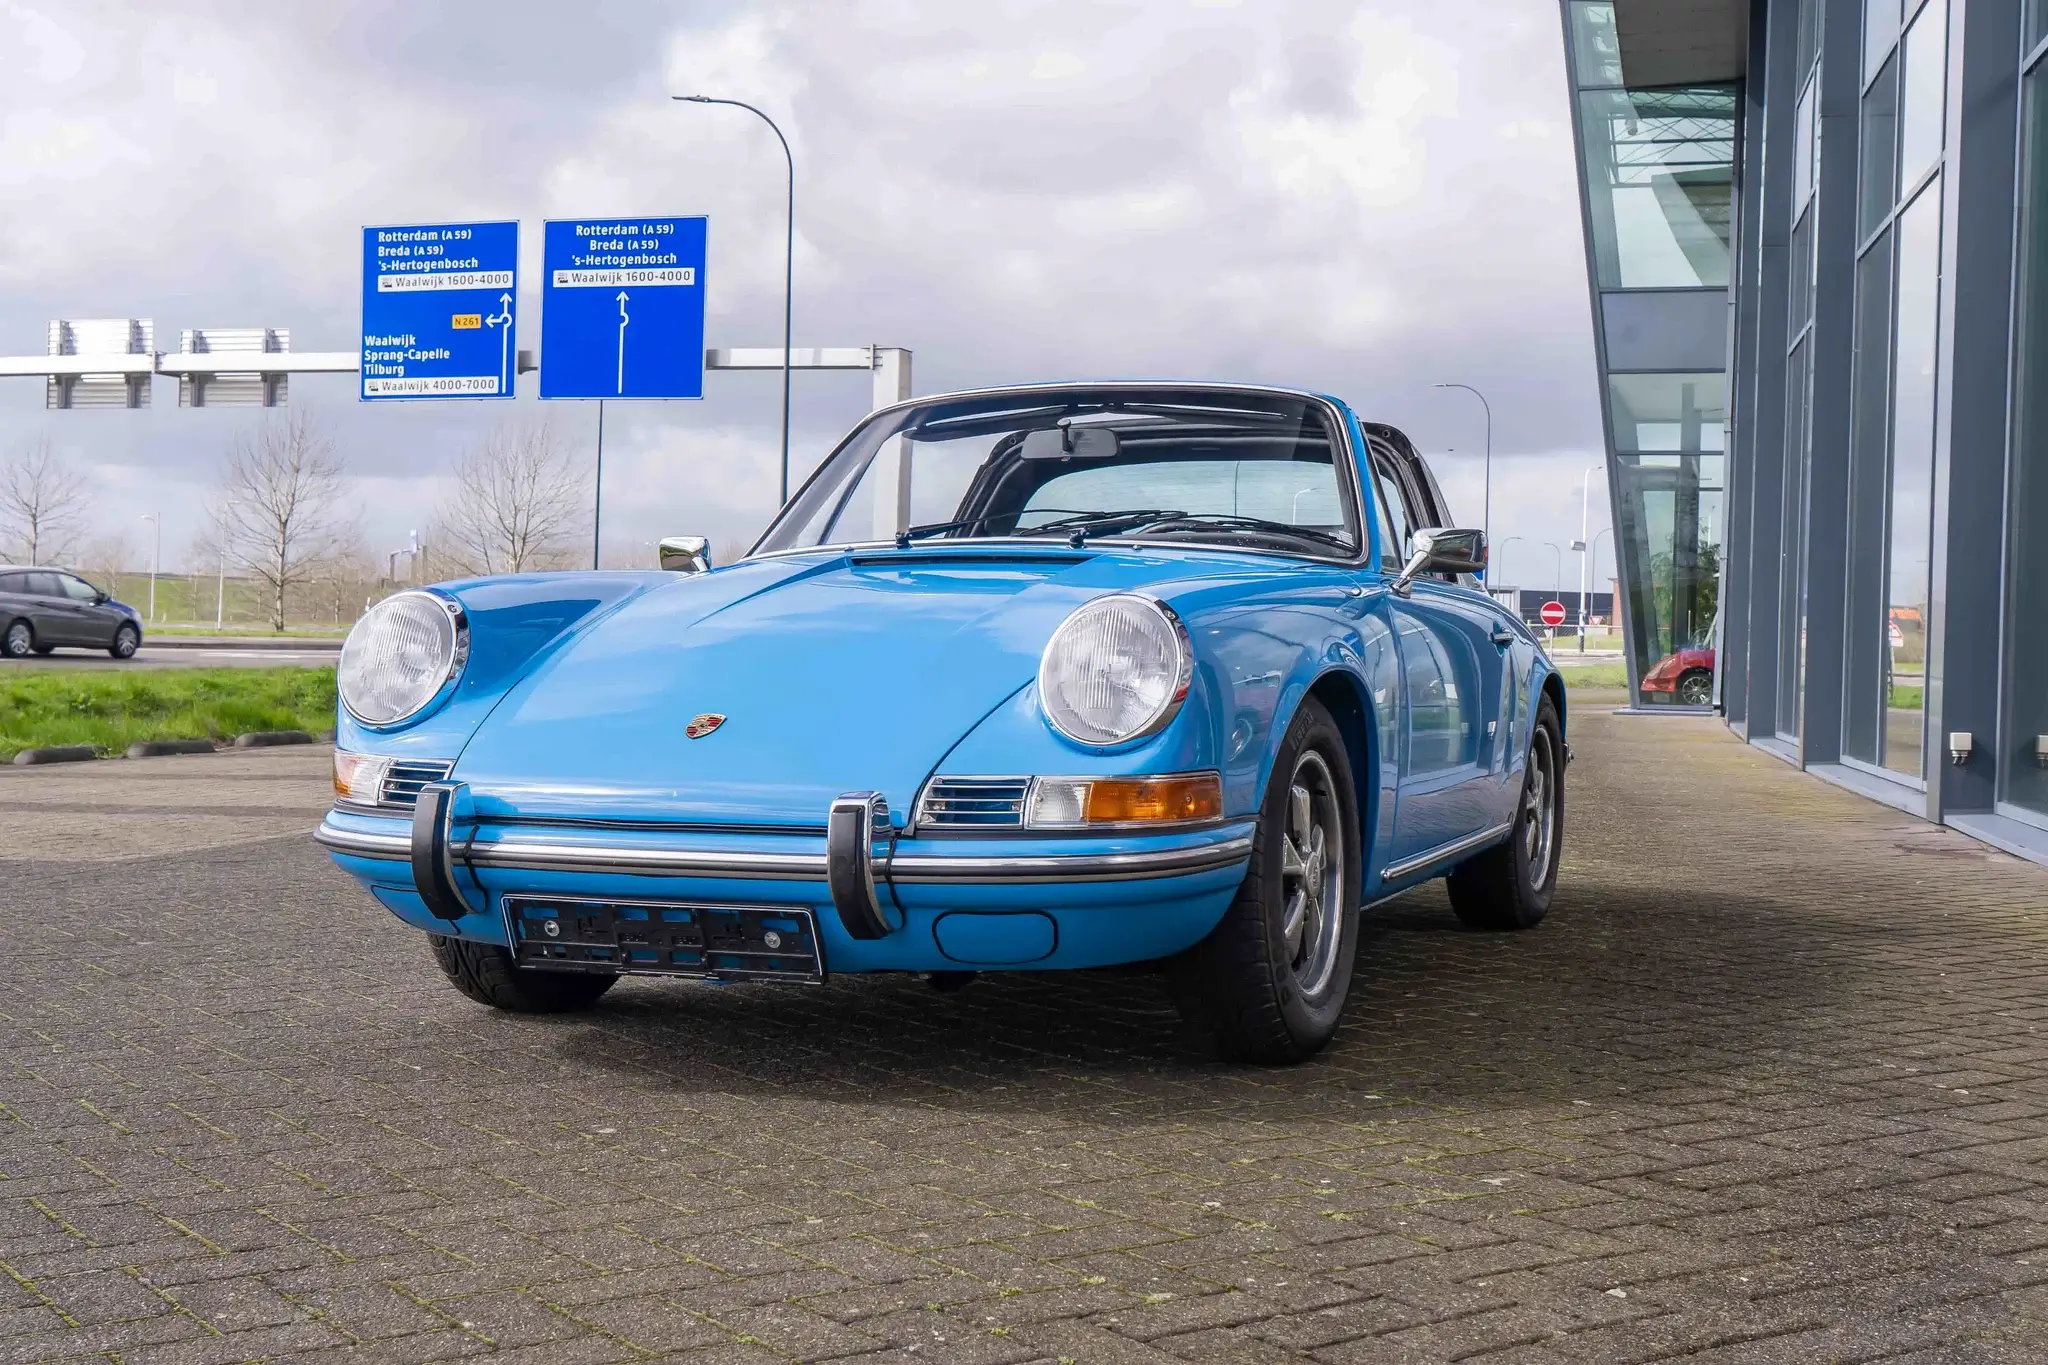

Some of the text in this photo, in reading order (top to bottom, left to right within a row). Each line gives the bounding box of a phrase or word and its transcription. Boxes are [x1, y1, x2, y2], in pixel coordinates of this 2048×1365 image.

[378, 230, 438, 242] Rotterdam
[576, 224, 638, 236] Rotterdam
[378, 245, 410, 257] Breda
[590, 239, 623, 250] Breda
[378, 257, 478, 272] 's-Hertogenbosch
[572, 253, 677, 267] 's-Hertogenbosch
[395, 274, 509, 288] Waalwijk 1600-4000
[571, 270, 690, 284] Waalwijk 1600-4000
[365, 335, 416, 348] Waalwijk
[365, 348, 450, 362] Sprang-Capelle
[364, 364, 404, 377] Tilburg
[382, 379, 495, 393] Waalwijk 4000-7000
